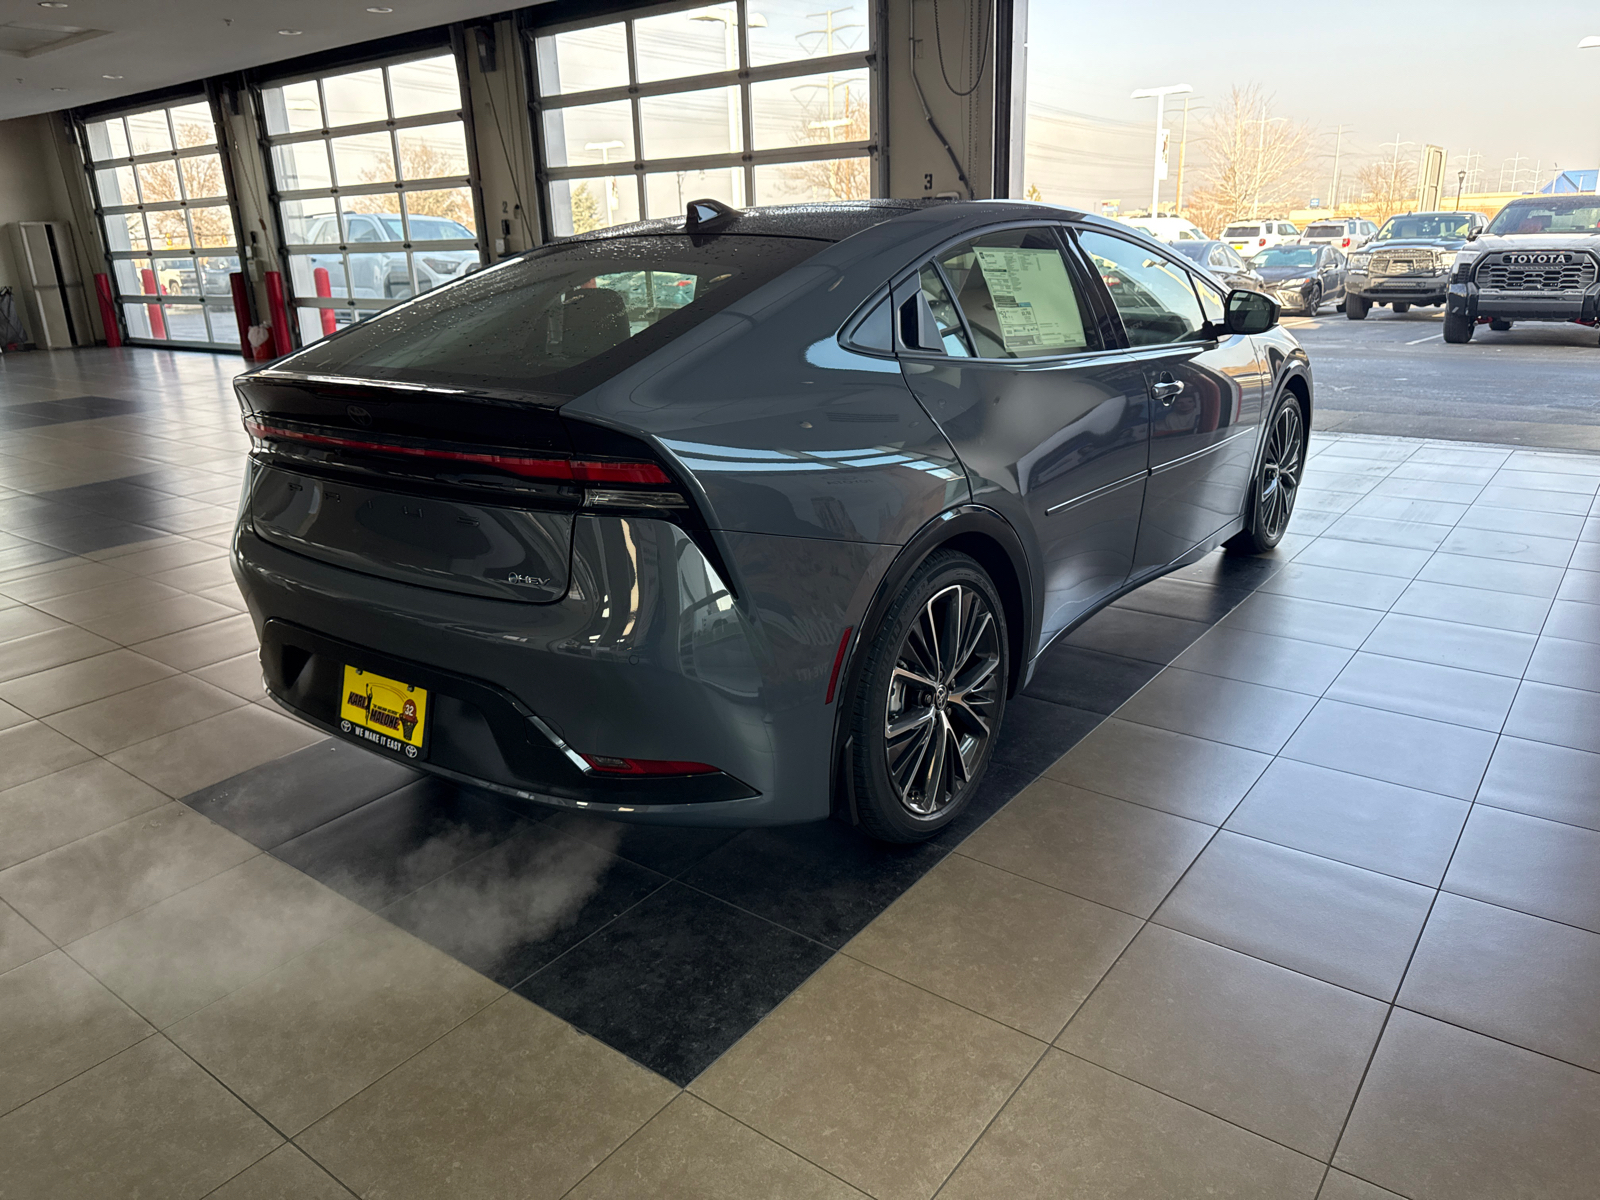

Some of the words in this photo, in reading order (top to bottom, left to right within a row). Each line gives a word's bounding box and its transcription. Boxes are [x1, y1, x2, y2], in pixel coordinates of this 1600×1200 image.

[924, 173, 933, 190] 3
[502, 201, 508, 213] 2
[1509, 254, 1566, 264] TOYOTA
[873, 623, 901, 706] MICHELIN
[347, 691, 367, 710] KARL
[404, 704, 414, 717] 32
[355, 726, 364, 737] WE
[364, 729, 379, 744] MAKE
[380, 736, 386, 747] IT
[386, 739, 401, 751] EASY
